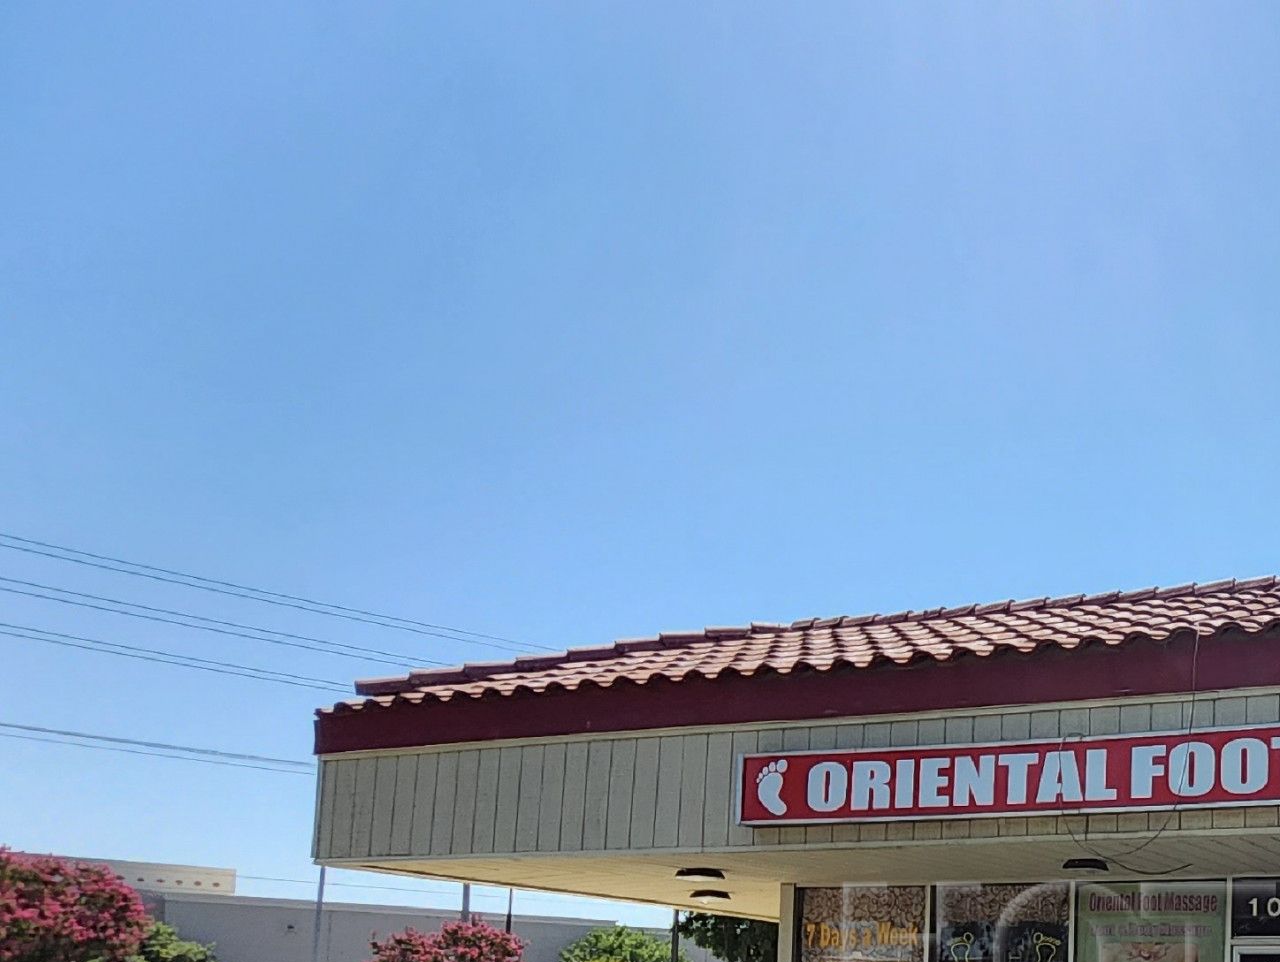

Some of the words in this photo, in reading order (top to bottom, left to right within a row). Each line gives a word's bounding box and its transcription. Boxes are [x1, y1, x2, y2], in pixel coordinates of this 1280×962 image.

[806, 749, 1118, 812] ORIENTAL
[1163, 891, 1217, 912] Massage
[806, 923, 815, 948] 7
[820, 922, 858, 951] Days
[877, 921, 918, 946] Week
